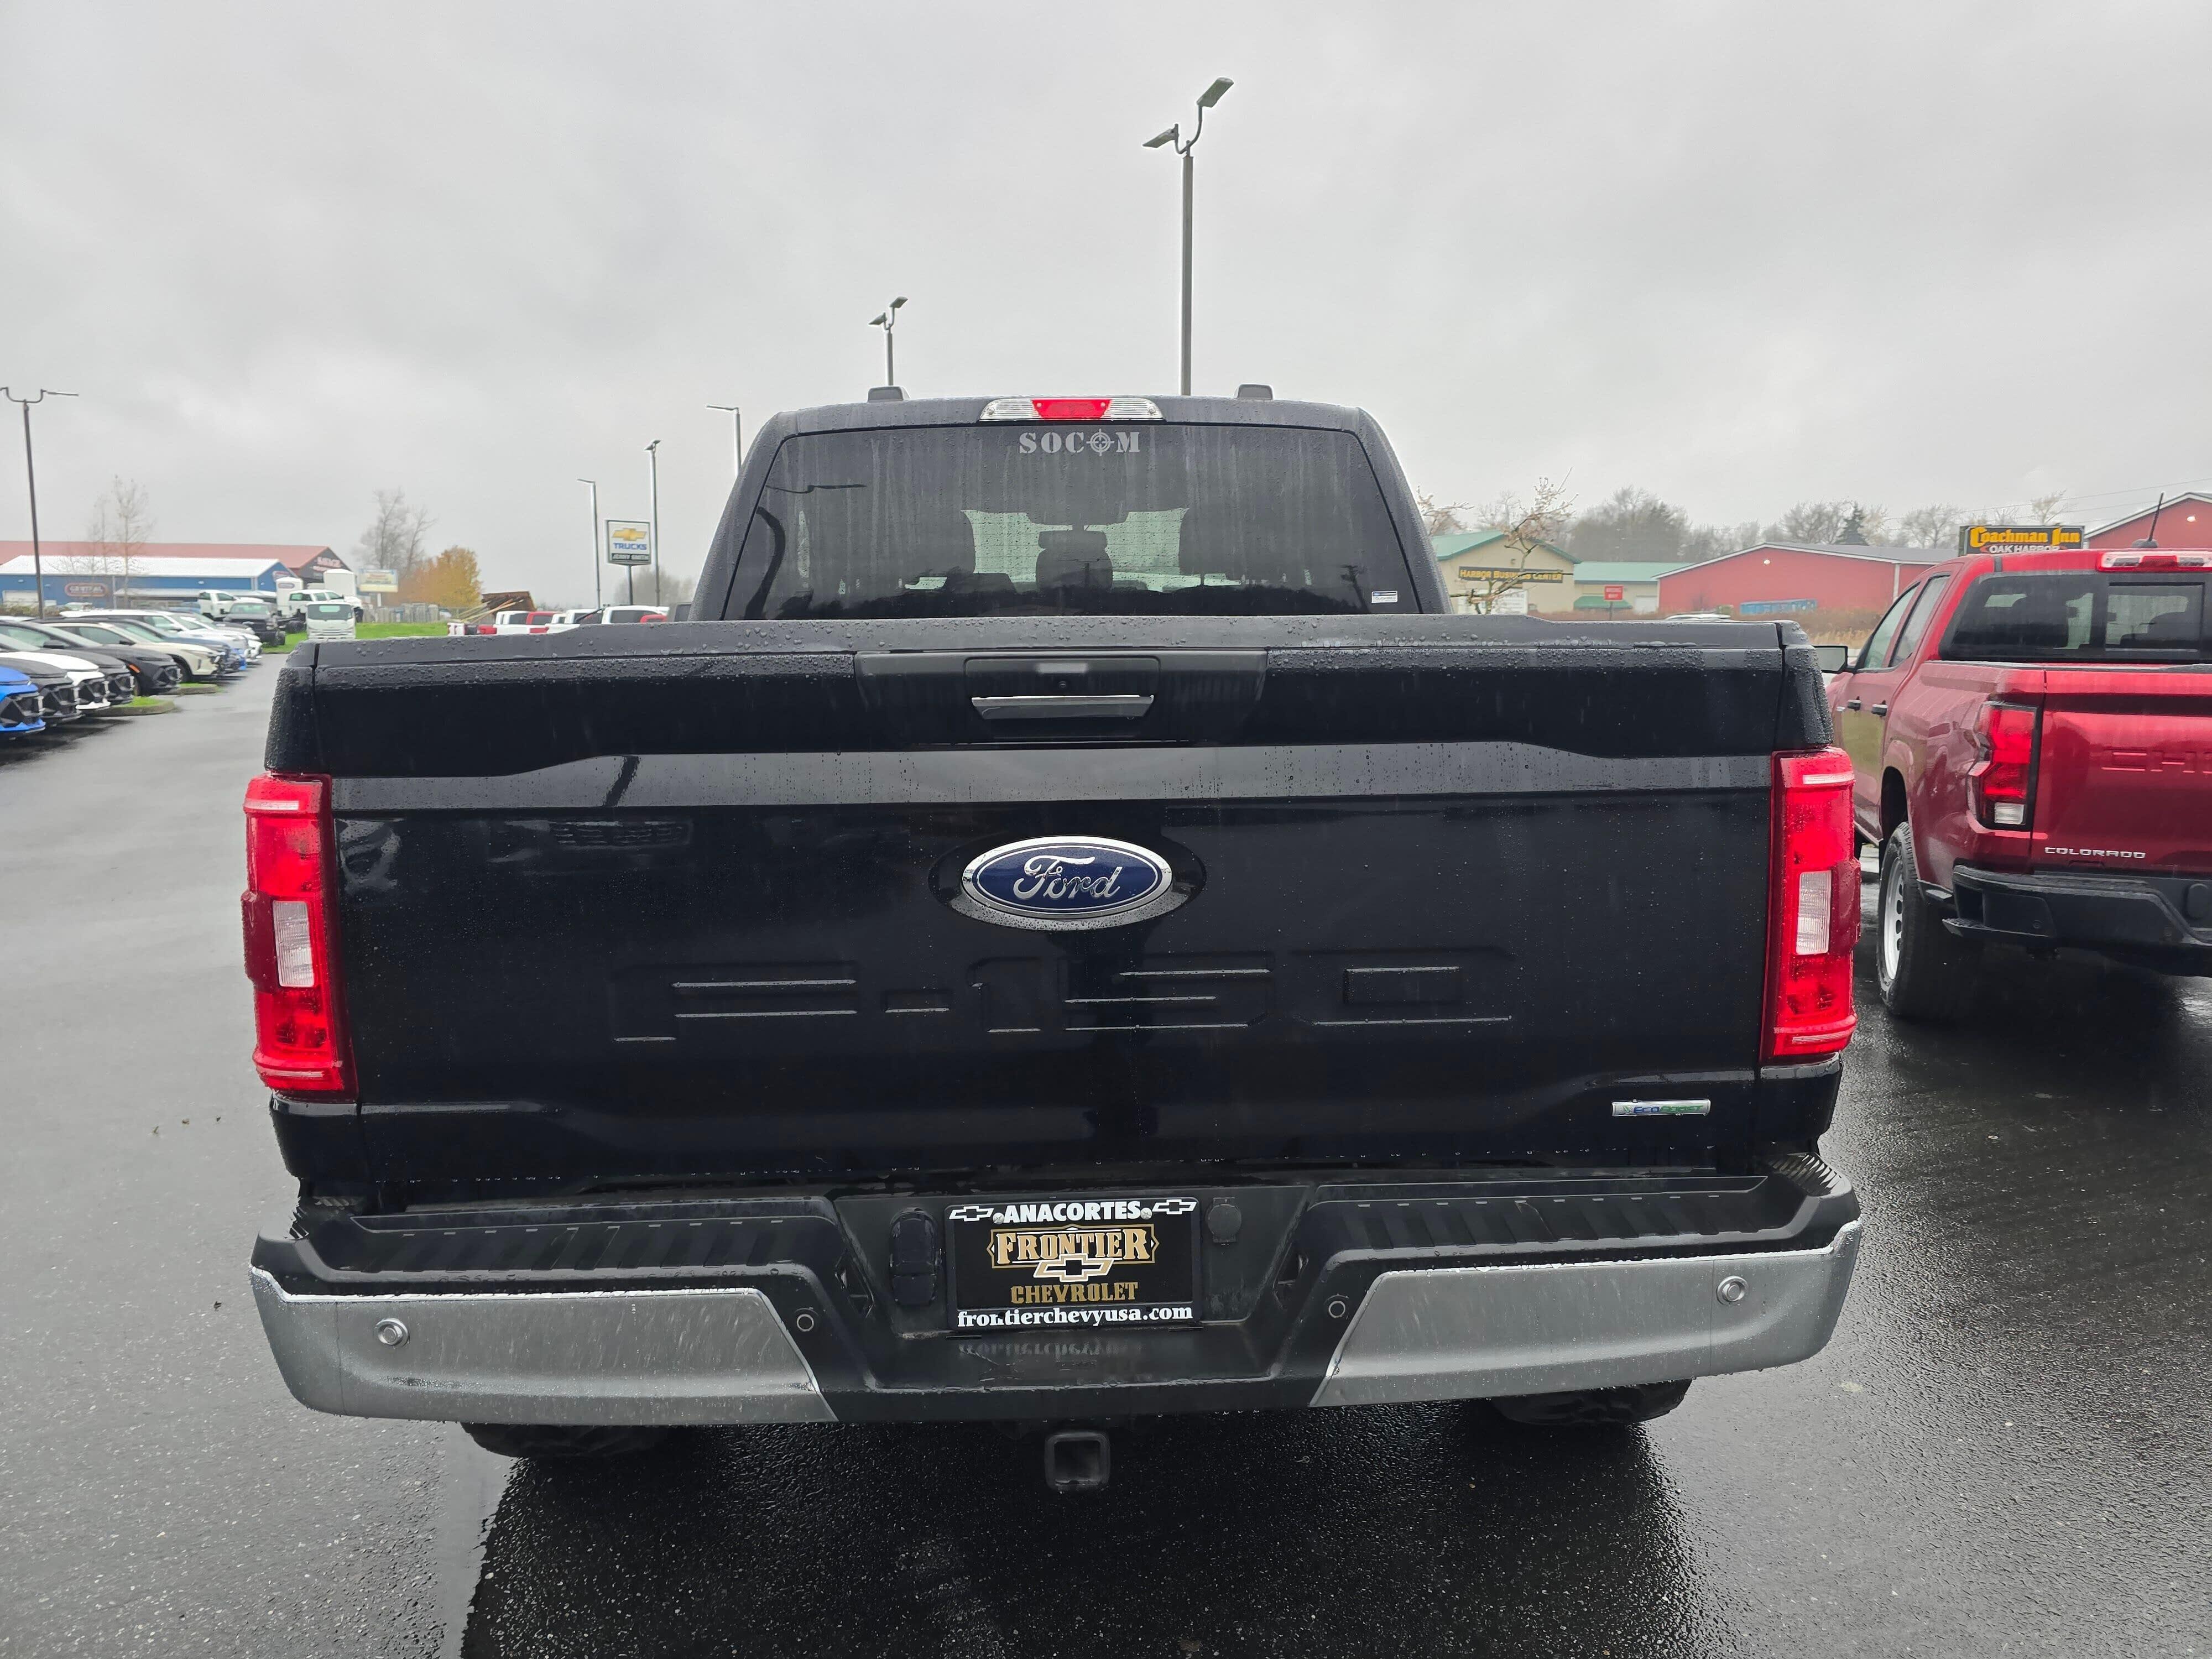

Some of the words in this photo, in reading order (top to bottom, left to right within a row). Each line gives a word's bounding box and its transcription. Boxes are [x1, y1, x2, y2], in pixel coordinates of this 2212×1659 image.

[1969, 526, 2048, 547] Coachman
[2051, 526, 2080, 546] Inn
[1989, 545, 2013, 553] OAK
[1460, 570, 1491, 578] HARBOR
[1494, 571, 1531, 580] BUSINSS
[2044, 847, 2146, 859] COLORADO
[1013, 855, 1123, 900] Ford
[1003, 1201, 1141, 1223] ANACORTES
[996, 1228, 1151, 1265] FRONTIER
[1010, 1281, 1139, 1304] CHEVROLET
[957, 1306, 1193, 1327] frontierchevyusa.com
